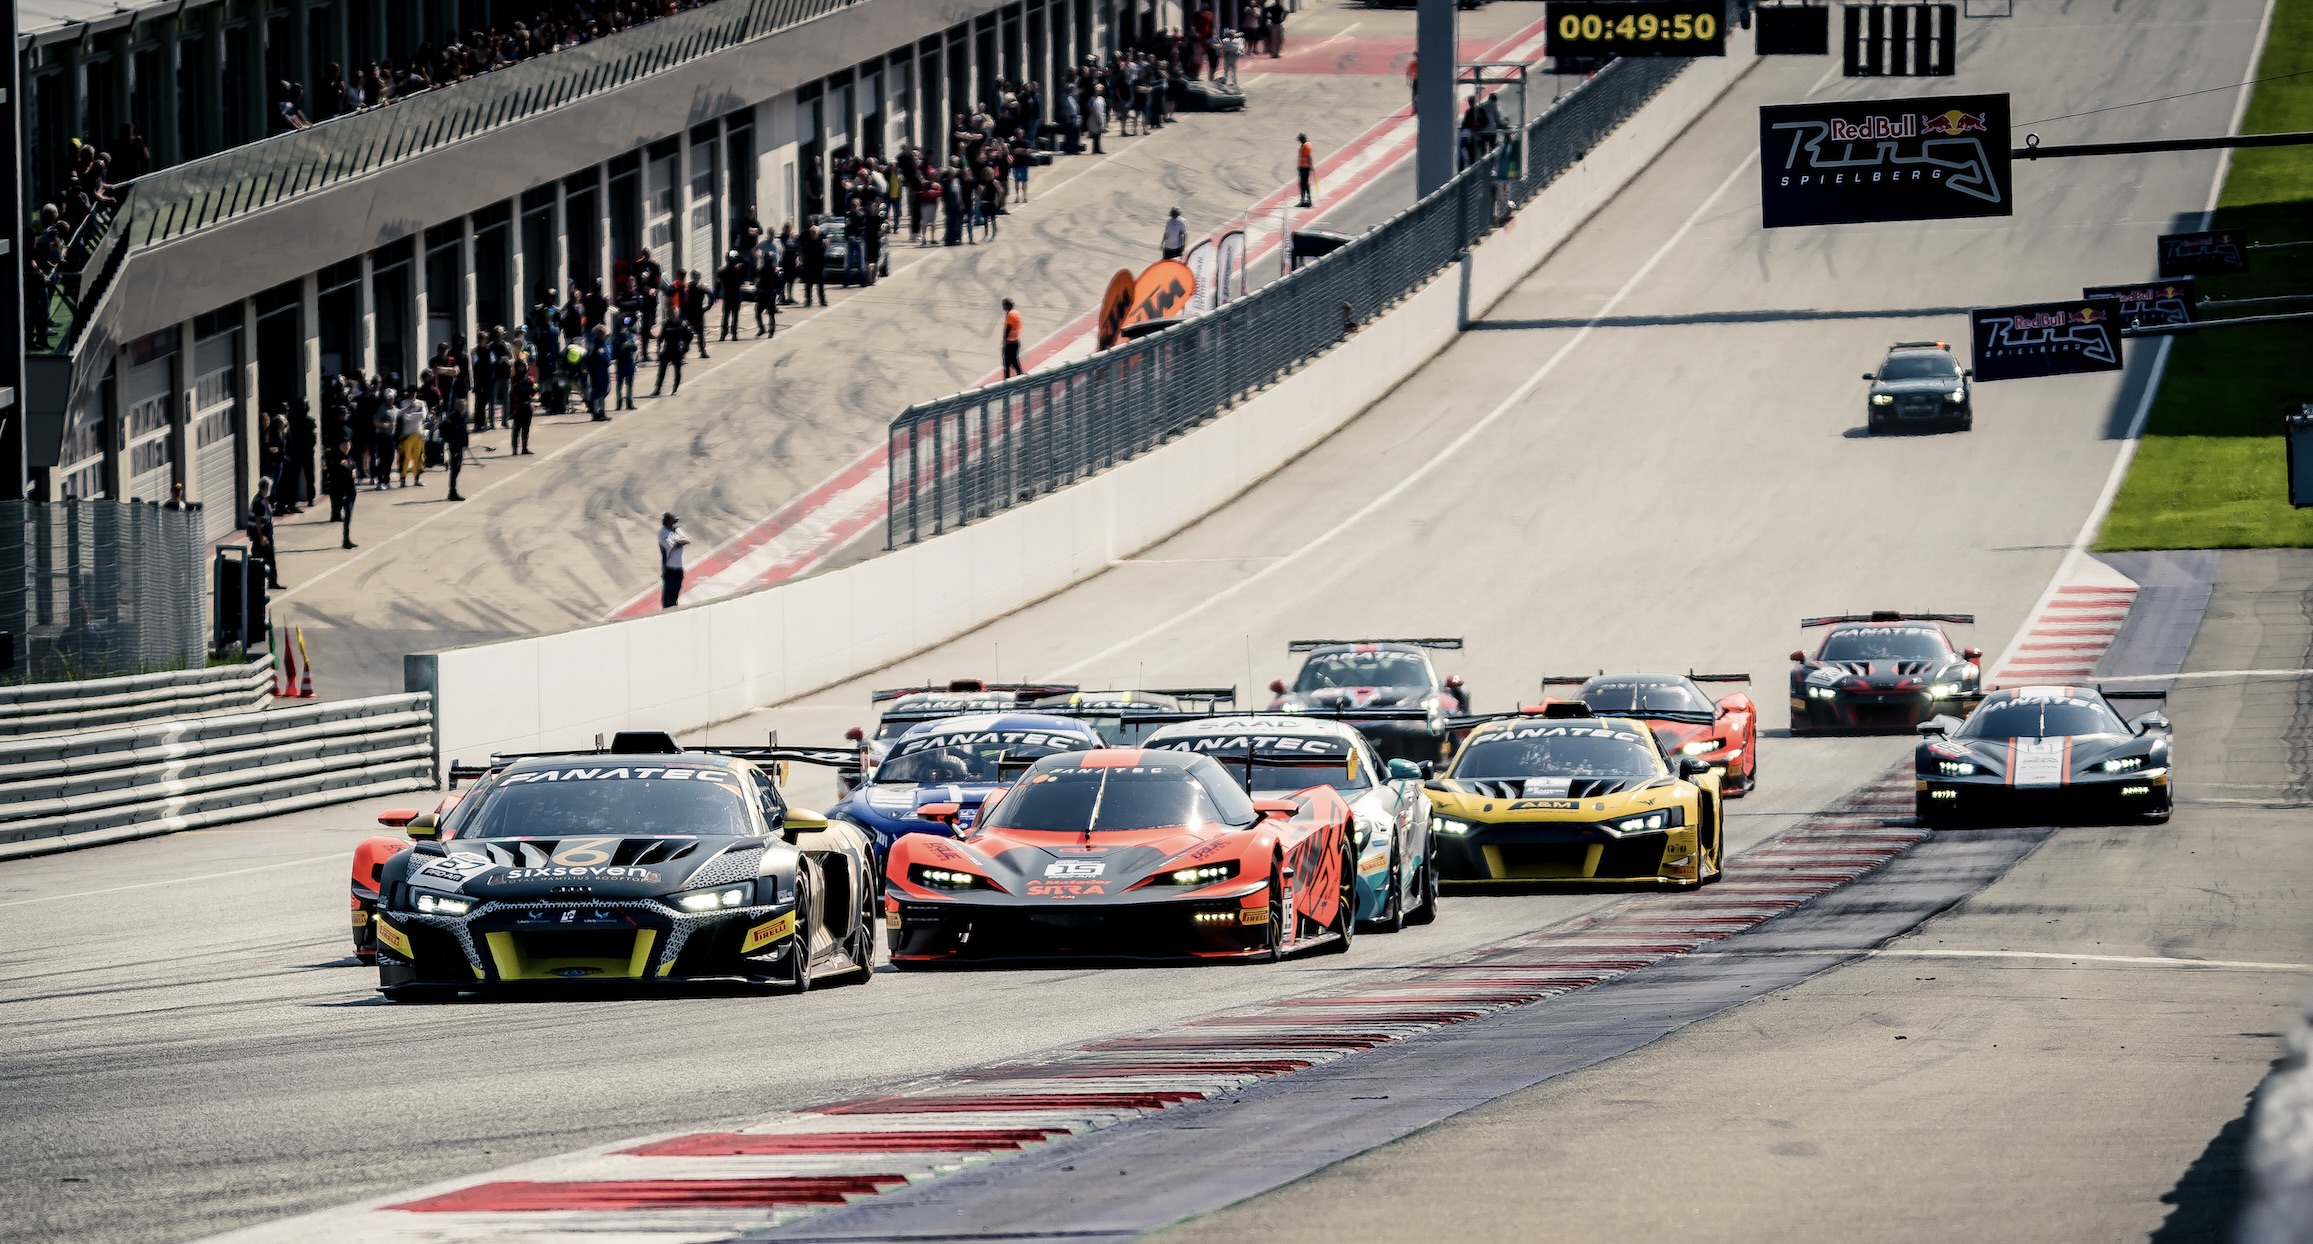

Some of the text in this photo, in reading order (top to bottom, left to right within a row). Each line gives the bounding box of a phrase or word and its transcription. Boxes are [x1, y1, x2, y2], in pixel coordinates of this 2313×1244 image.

[1559, 13, 1717, 41] 00:49:50
[1781, 169, 1942, 187] SPIELBERG
[1985, 344, 2081, 358] SPIELBERG
[1199, 719, 1301, 730] SAAD
[901, 732, 1077, 755] FANATEC
[1471, 727, 1641, 747] FANATEC
[499, 767, 729, 787] FANATEC
[507, 866, 648, 879] sixseven
[1055, 865, 1097, 875] 15
[1360, 856, 1386, 872] PIRELLI
[380, 924, 400, 947] PIRELLI
[753, 919, 787, 942] PIRELLI
